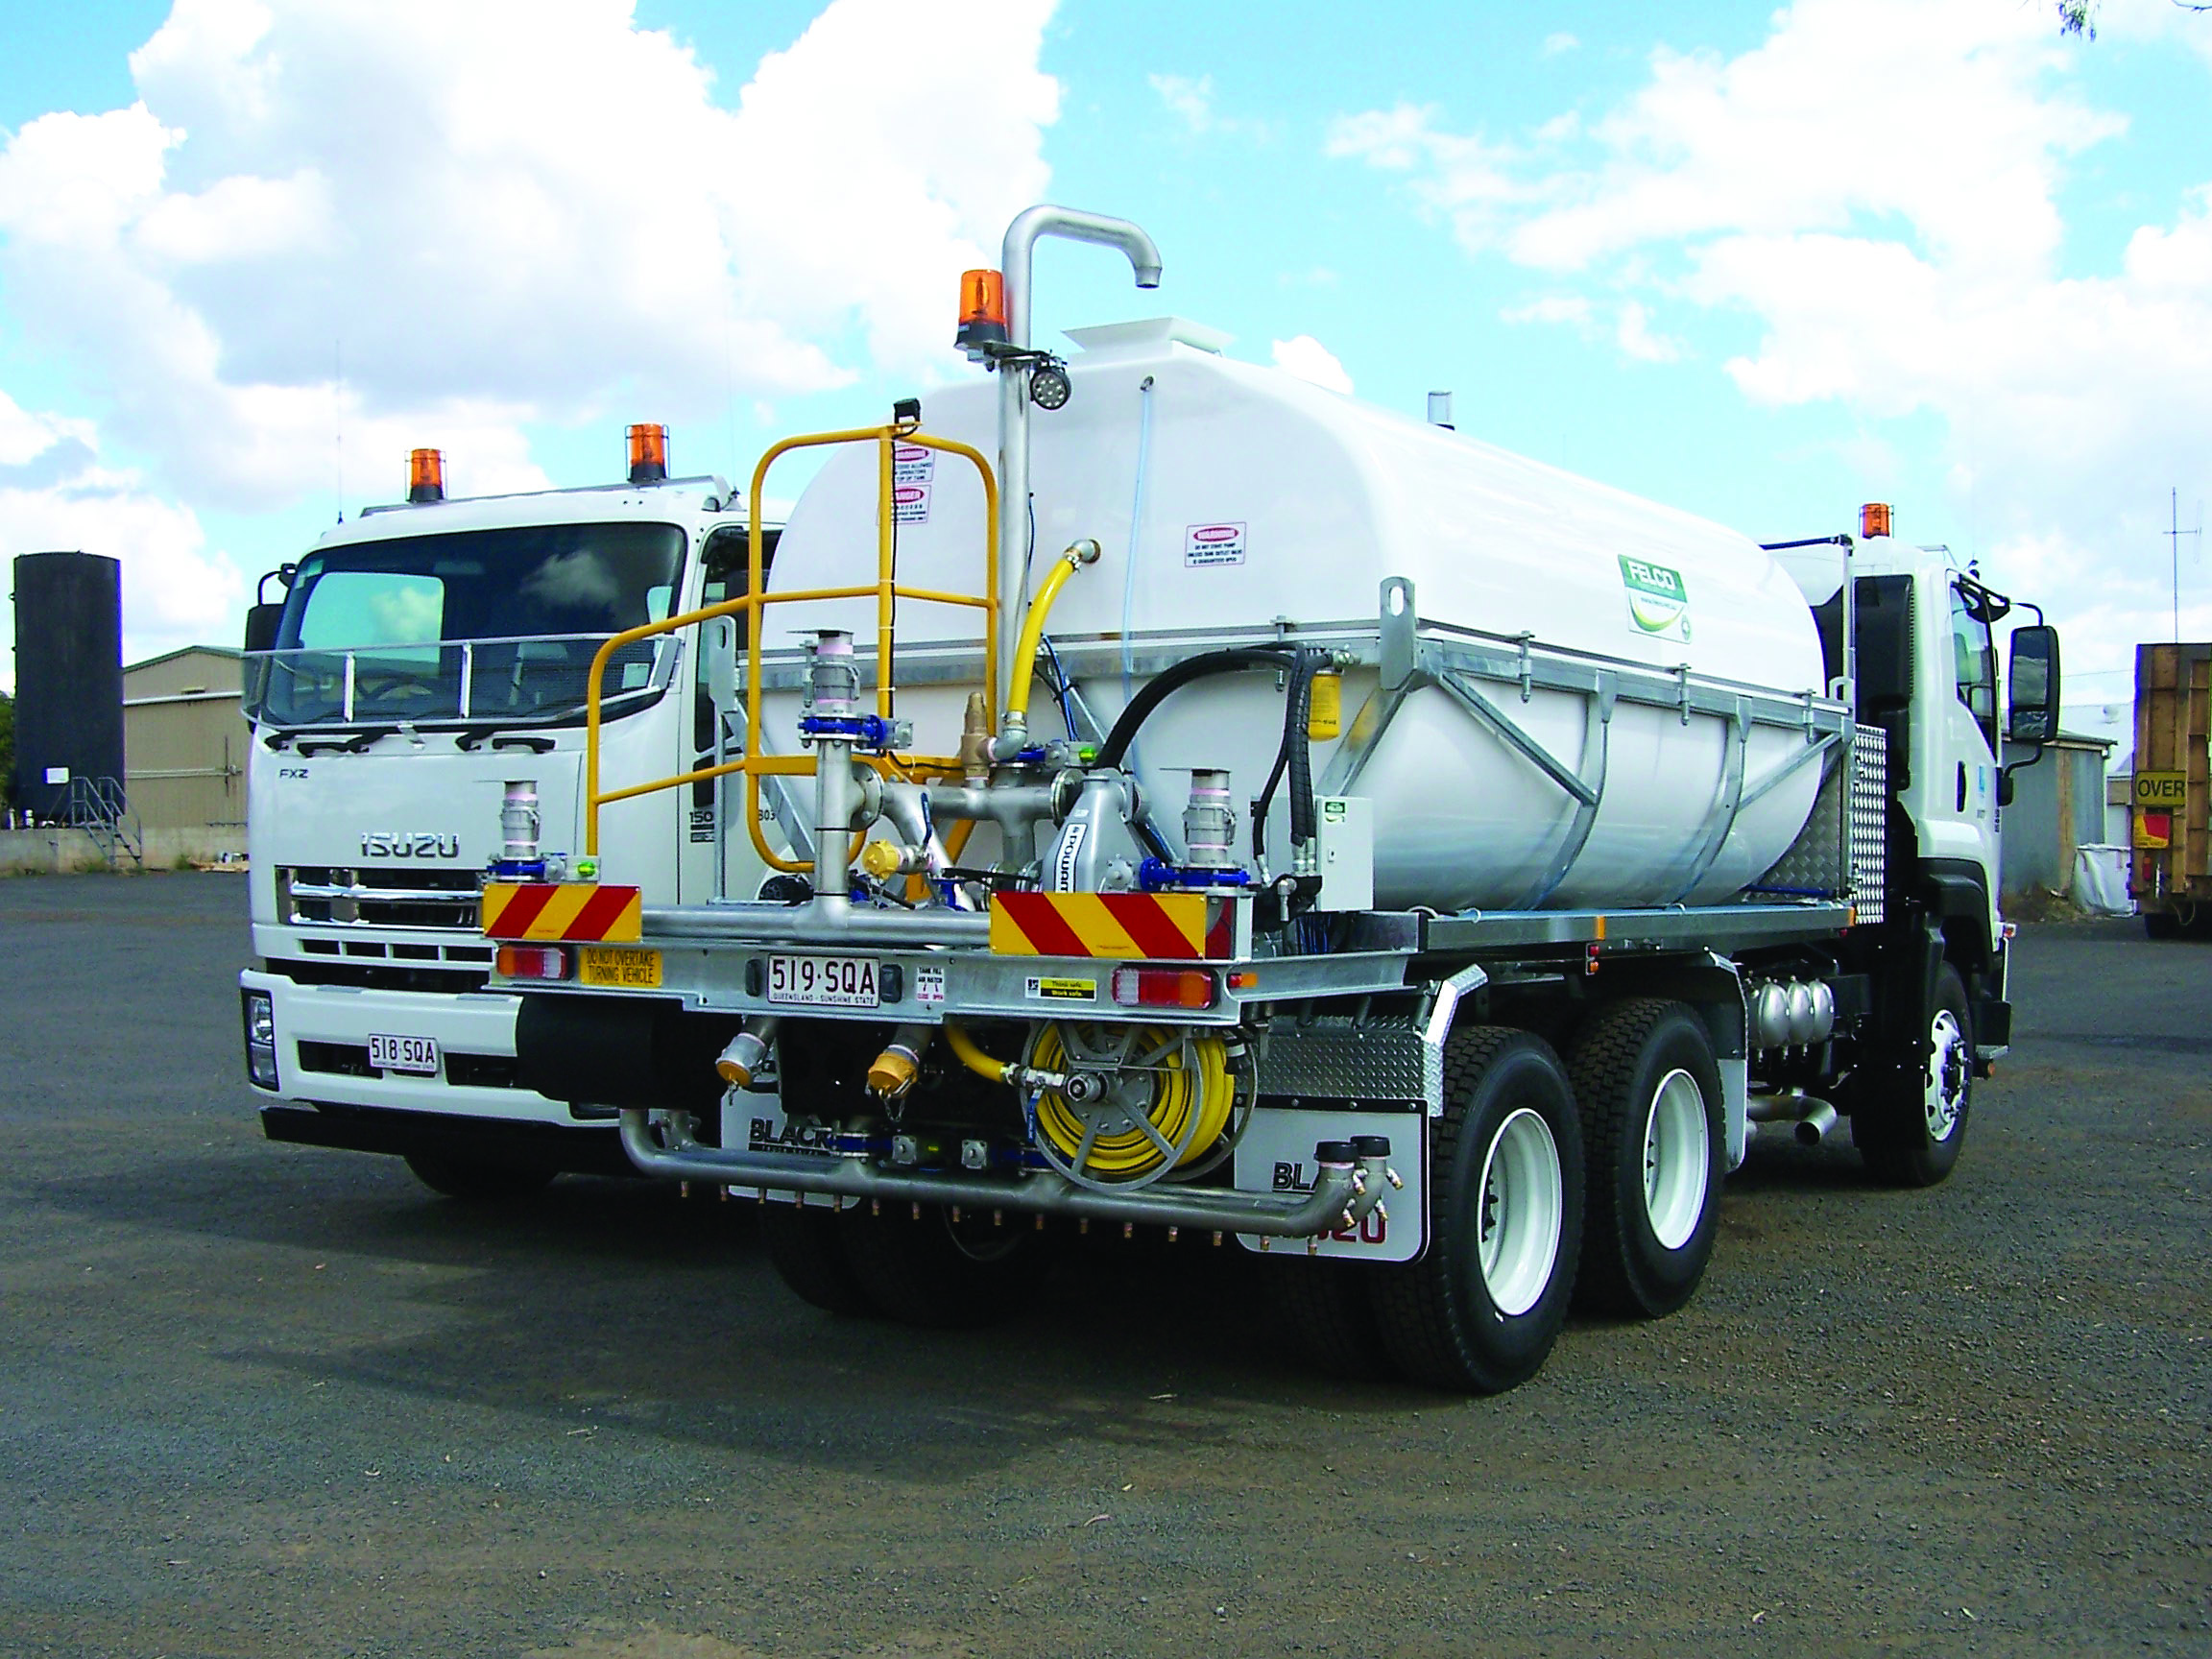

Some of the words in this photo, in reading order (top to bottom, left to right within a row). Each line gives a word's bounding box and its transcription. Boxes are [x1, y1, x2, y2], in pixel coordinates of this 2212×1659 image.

[1626, 560, 1677, 590] FELCO
[279, 769, 308, 779] FXZ
[2137, 780, 2185, 797] OVER
[361, 832, 460, 857] ISUZU
[772, 993, 813, 1002] QUEENSLAND
